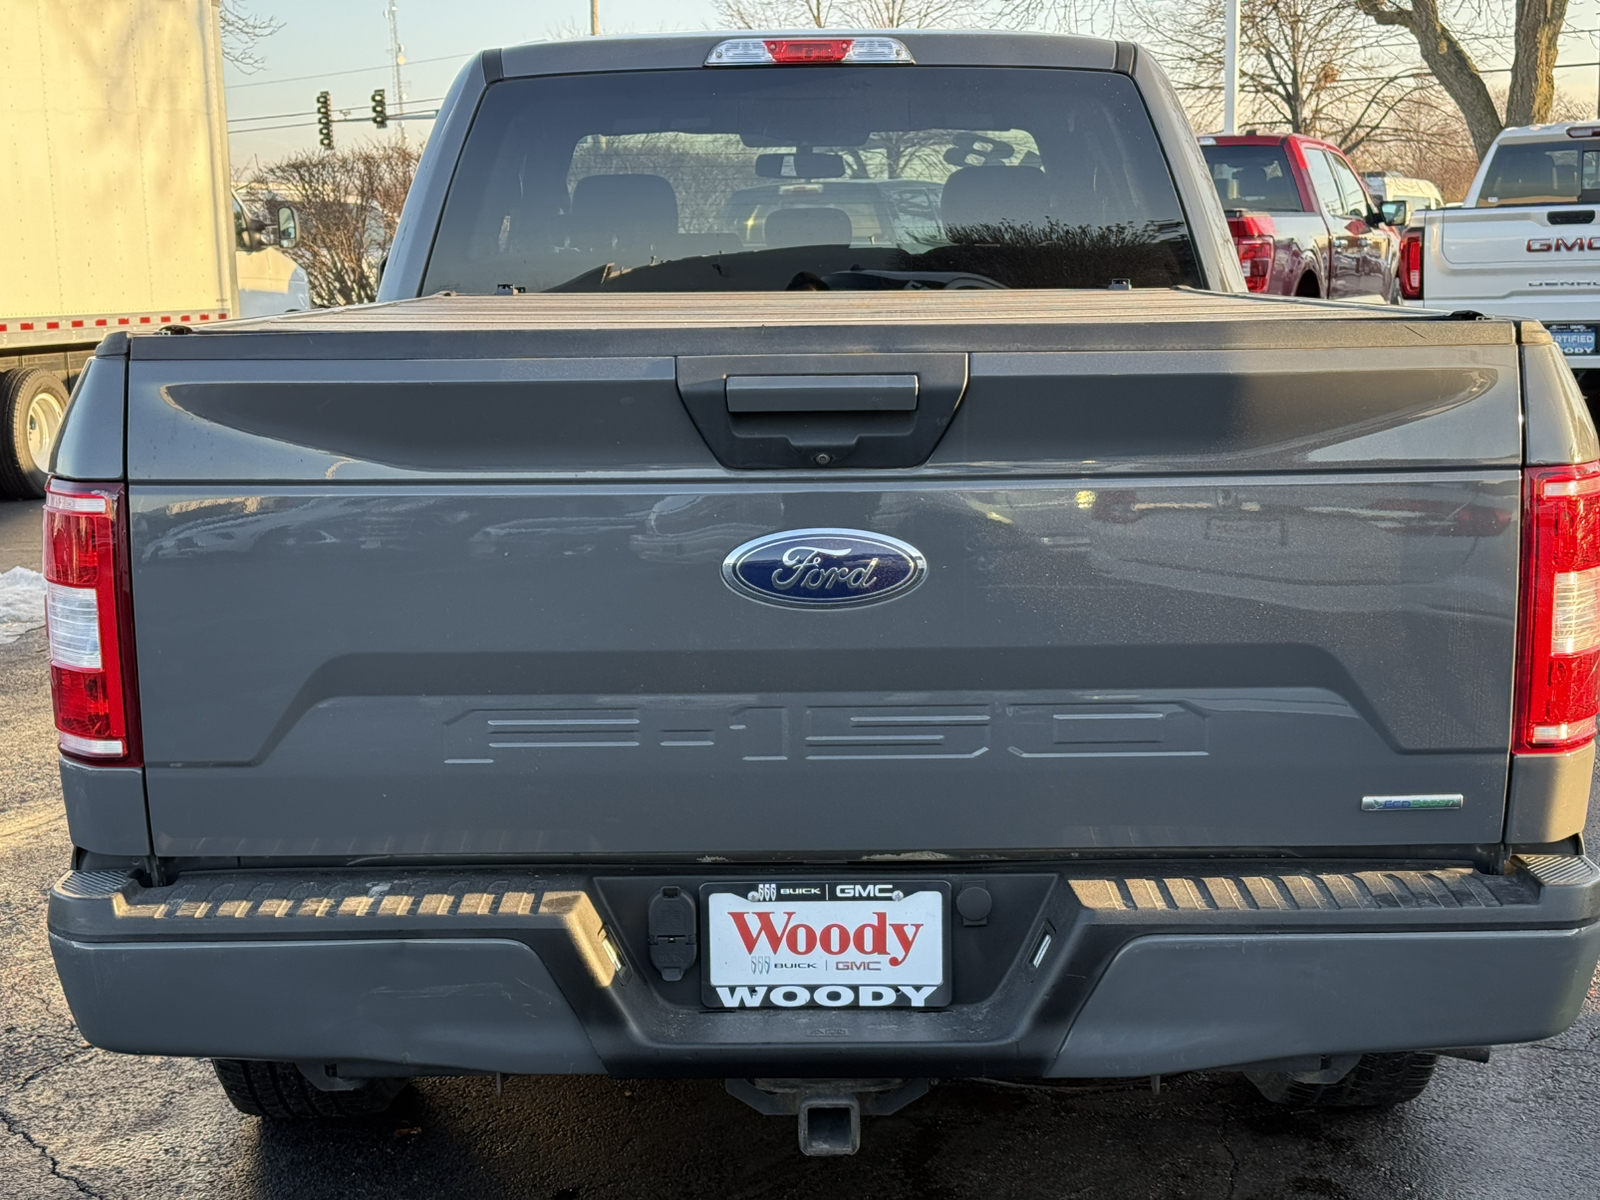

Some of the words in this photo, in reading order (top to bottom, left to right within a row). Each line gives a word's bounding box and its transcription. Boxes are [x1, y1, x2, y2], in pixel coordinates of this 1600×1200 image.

[771, 546, 879, 590] Ford
[444, 701, 1209, 765] F-150
[780, 887, 821, 895] BUICK
[835, 884, 894, 898] GMC
[727, 911, 925, 967] Woody
[835, 960, 882, 971] GMC
[715, 985, 938, 1008] WOODY
